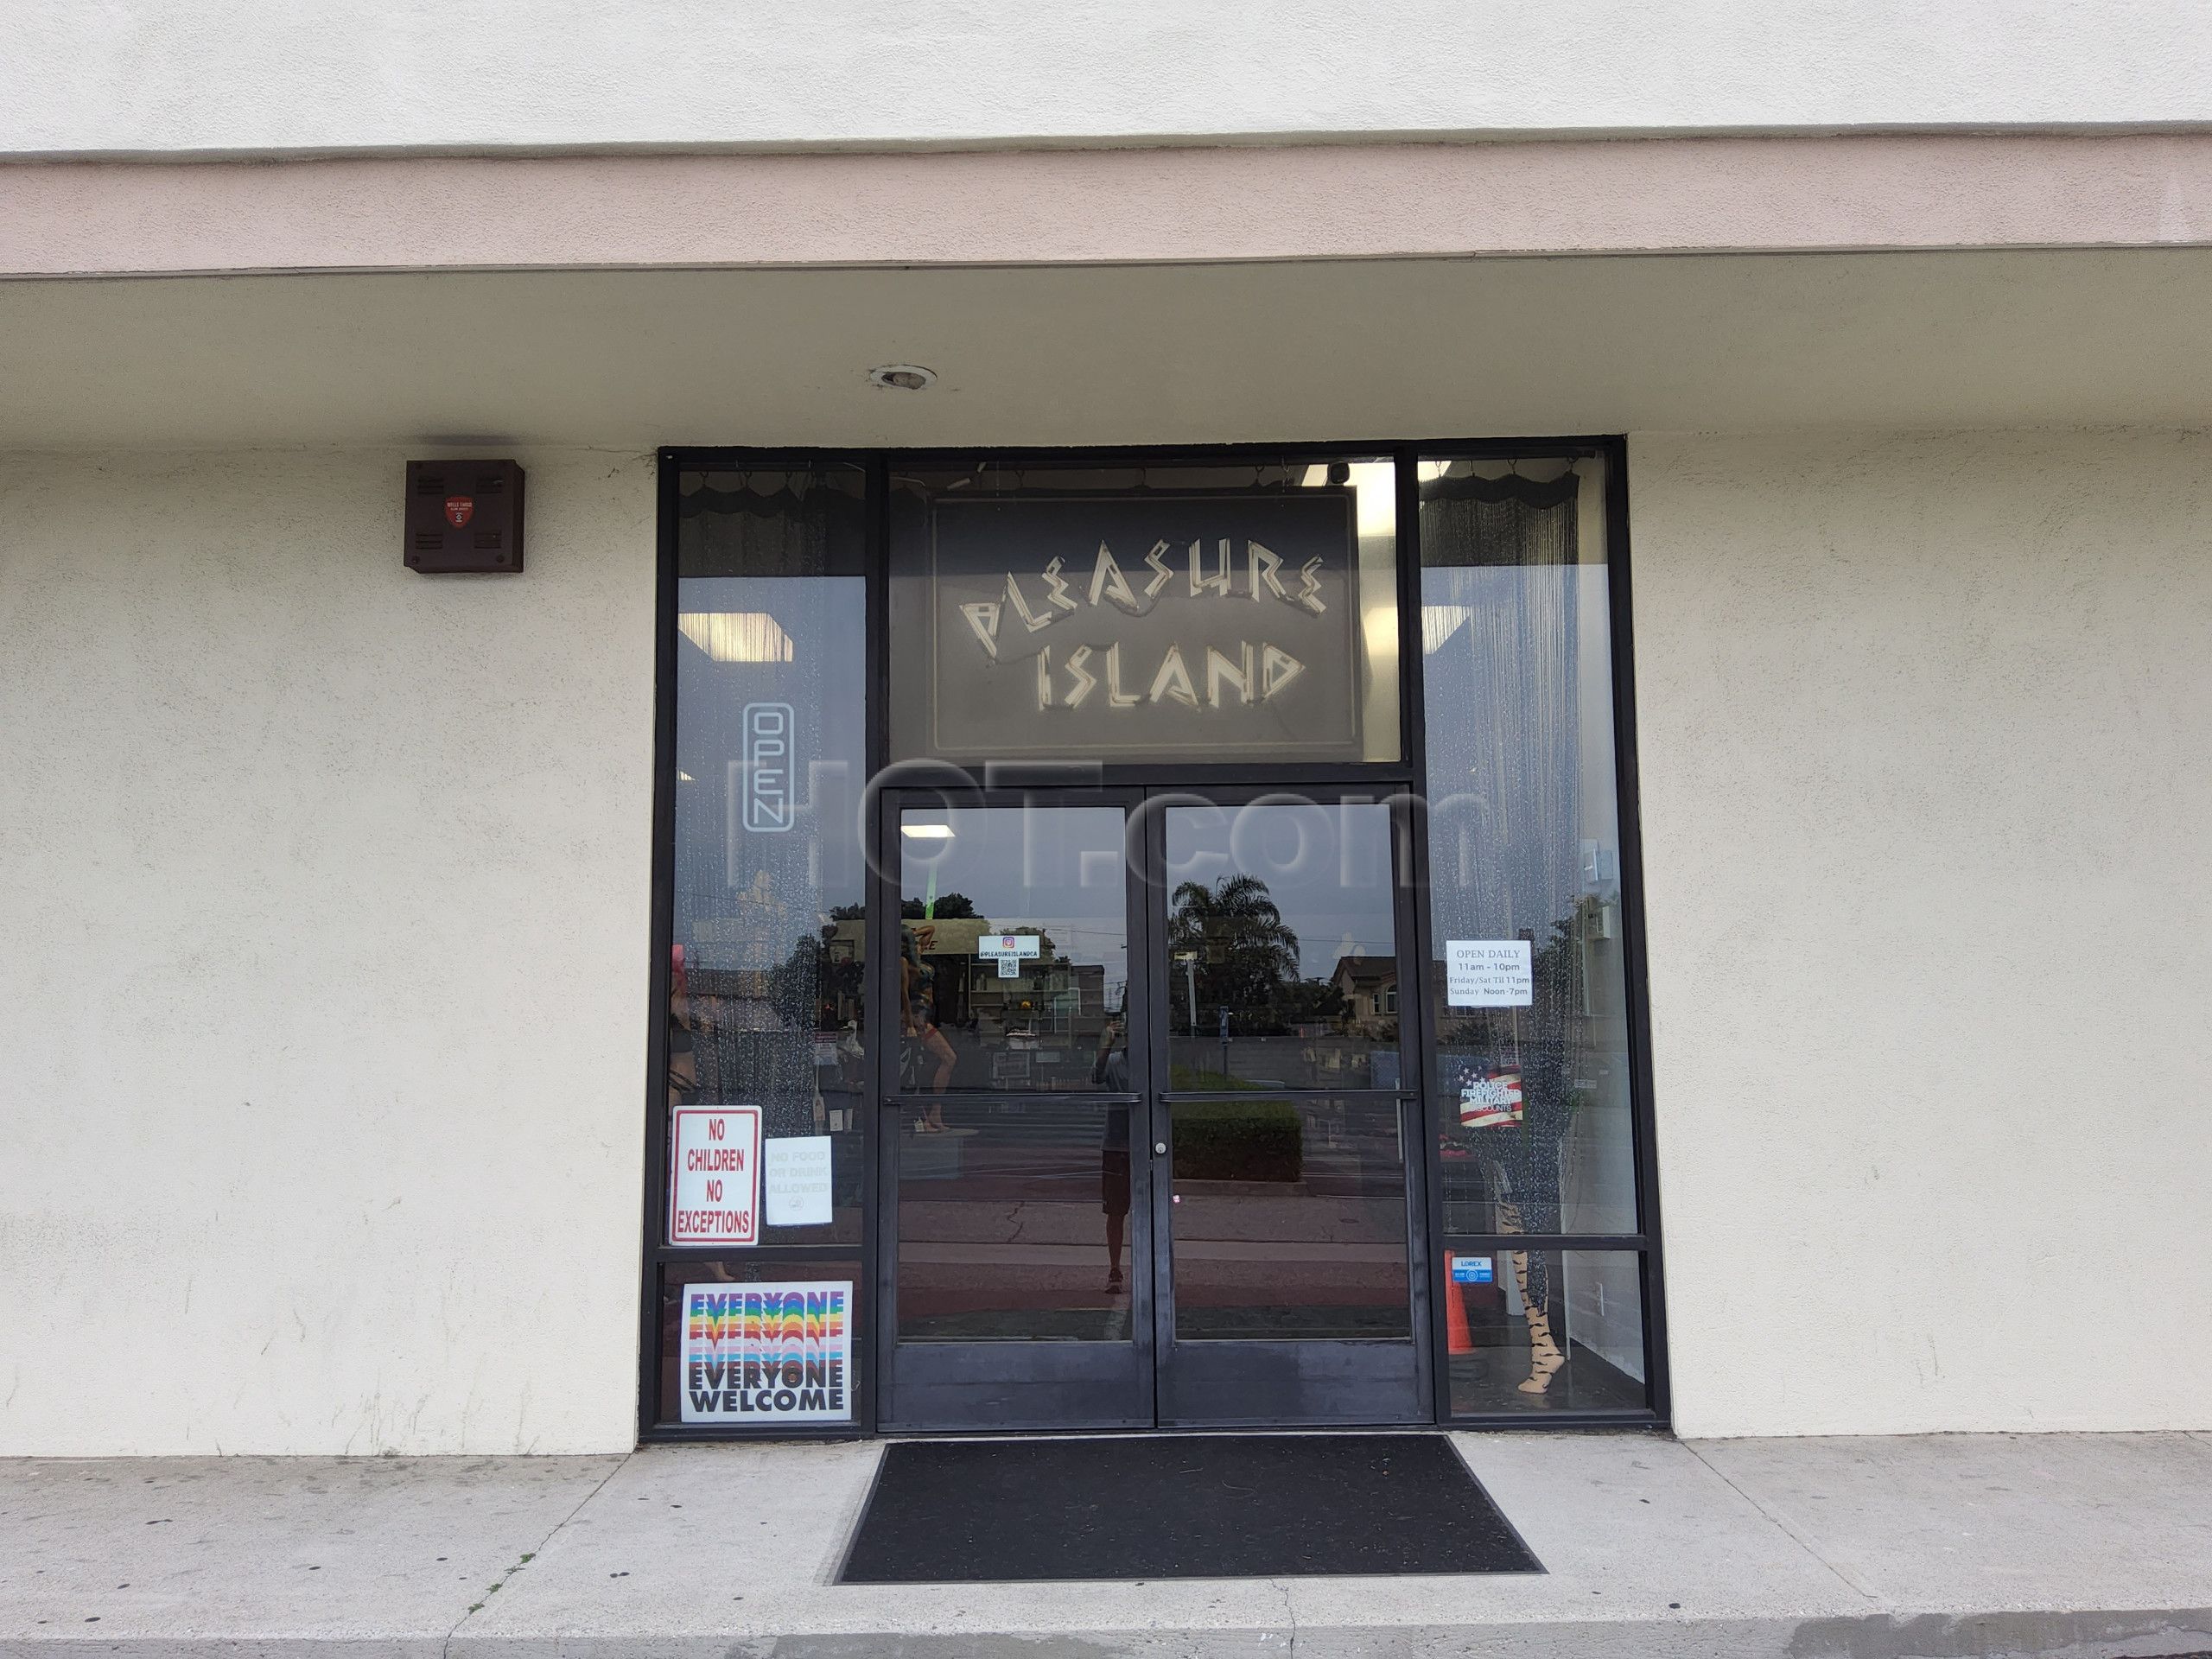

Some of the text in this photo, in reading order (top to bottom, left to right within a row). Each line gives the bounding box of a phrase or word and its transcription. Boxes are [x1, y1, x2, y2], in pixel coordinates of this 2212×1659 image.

[959, 539, 1327, 657] PLEASURE
[1038, 641, 1307, 711] ISLAND
[753, 712, 785, 824] OPEN
[1457, 950, 1521, 958] OPEN DAILY
[1493, 963, 1520, 972] 10pm
[1472, 1081, 1508, 1090] POLICE
[709, 1119, 725, 1141] NO
[687, 1149, 745, 1172] CHILDREN
[706, 1179, 722, 1202] NO
[677, 1211, 749, 1233] EXCEPTIONS
[689, 1364, 843, 1389] EVERYONE
[689, 1389, 844, 1413] WELCOME
